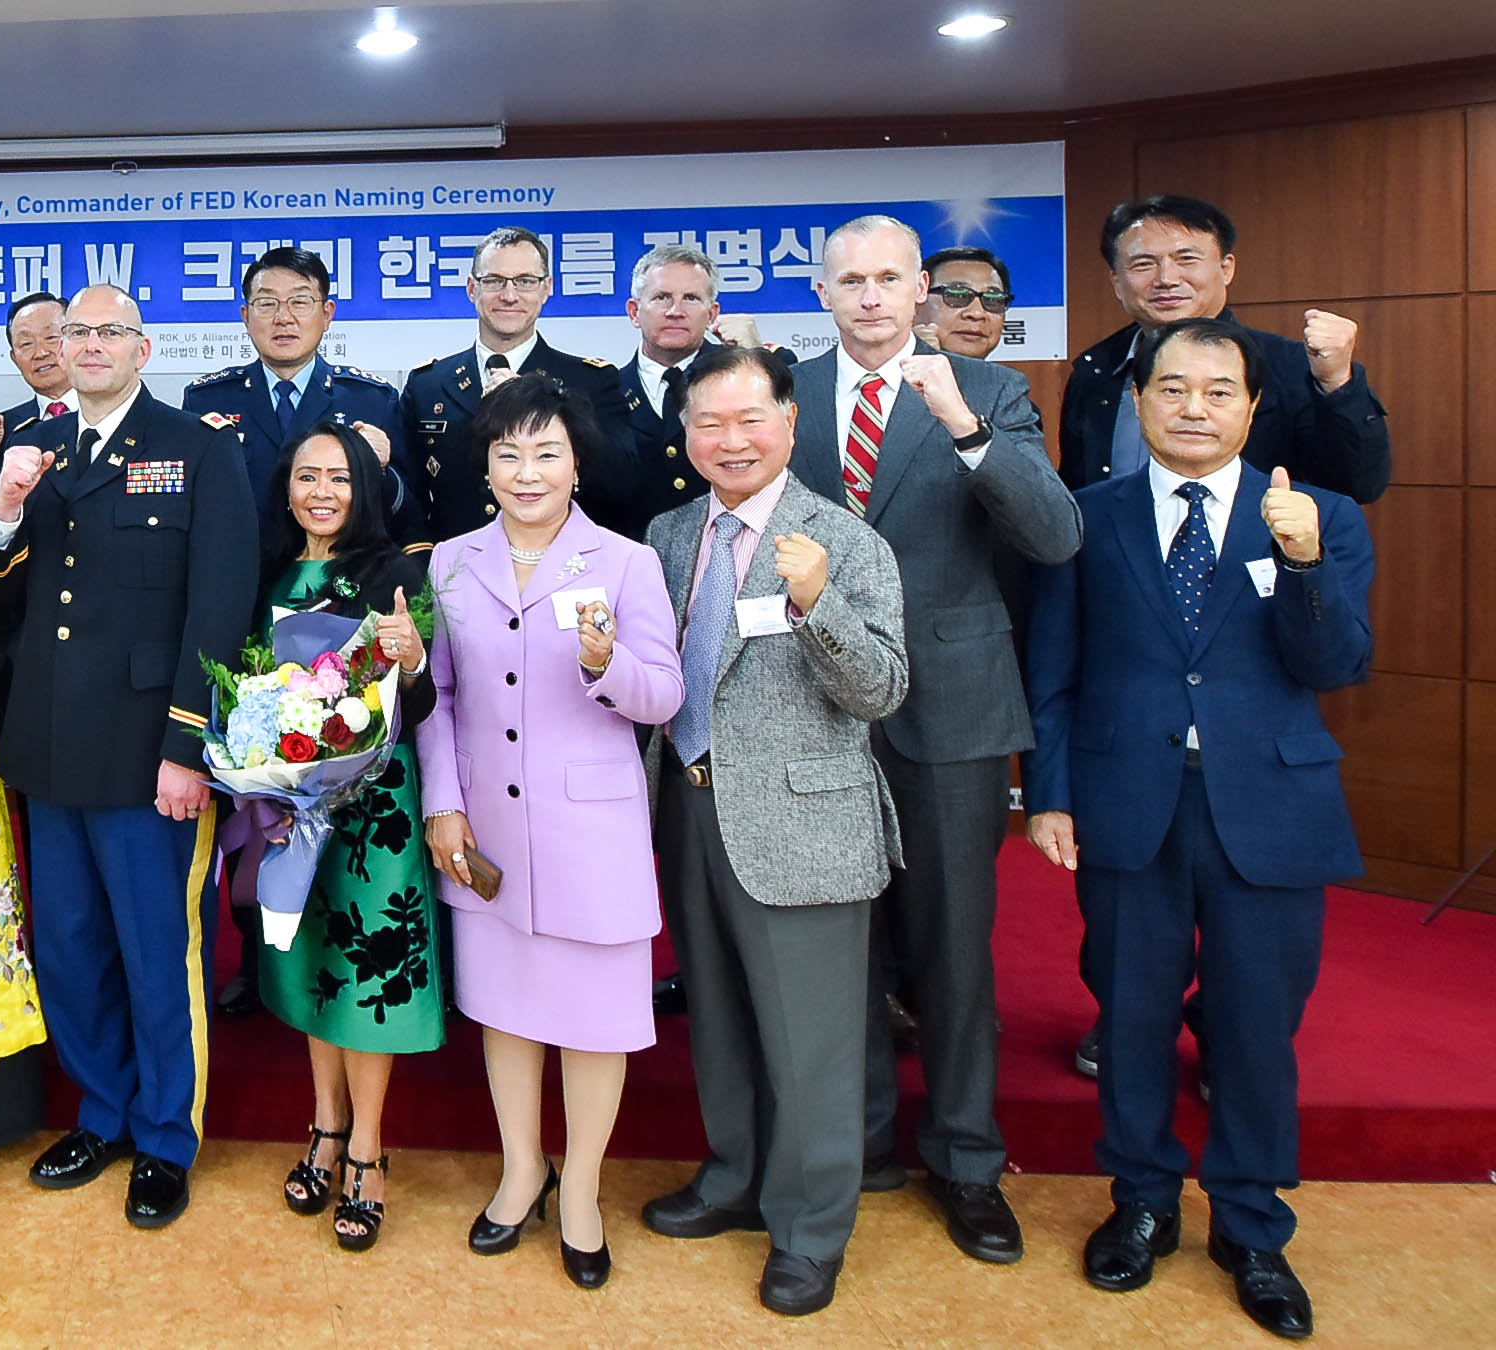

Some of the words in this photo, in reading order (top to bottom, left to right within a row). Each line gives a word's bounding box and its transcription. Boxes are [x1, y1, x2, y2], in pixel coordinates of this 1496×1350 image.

[16, 193, 154, 214] Commander
[161, 192, 184, 211] of
[190, 191, 236, 210] FED
[243, 189, 327, 209] Korean
[335, 186, 425, 210] Naming
[431, 184, 556, 208] Ceremony
[84, 243, 151, 301] W.
[202, 332, 239, 342] Alliance
[323, 331, 346, 340] ation
[791, 333, 839, 351] Spons
[159, 346, 197, 359] 사단법인
